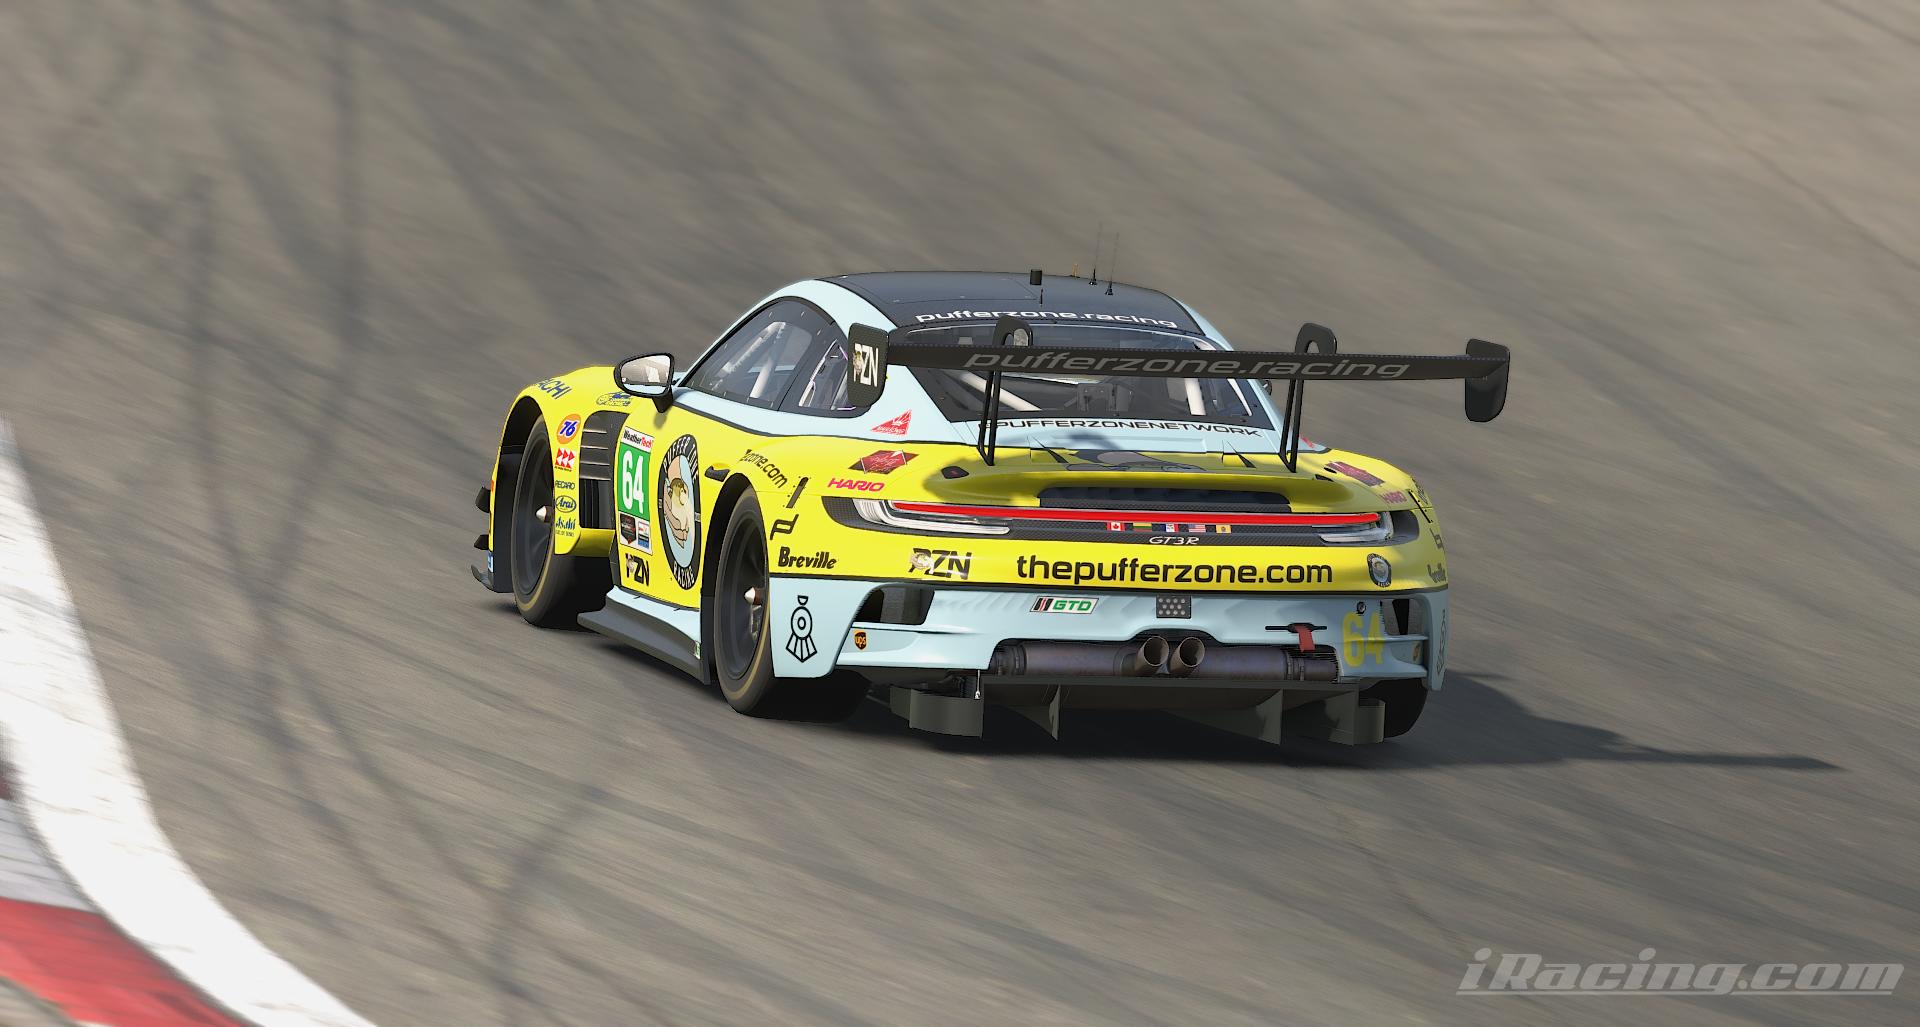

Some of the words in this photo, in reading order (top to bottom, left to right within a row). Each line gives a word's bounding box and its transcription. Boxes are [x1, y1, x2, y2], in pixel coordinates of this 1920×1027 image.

[915, 310, 1178, 329] pufferzone.racing
[963, 351, 1411, 379] pufferzone.racing
[559, 421, 579, 437] 76
[623, 430, 653, 449] WeatherTech
[621, 450, 645, 514] 64
[828, 478, 885, 492] HARIO
[778, 546, 838, 570] Breville
[673, 560, 695, 589] RACING
[1016, 554, 1333, 585] thepufferzone.com
[1052, 599, 1093, 612] GTD
[855, 636, 867, 648] ups
[1342, 610, 1385, 668] 64
